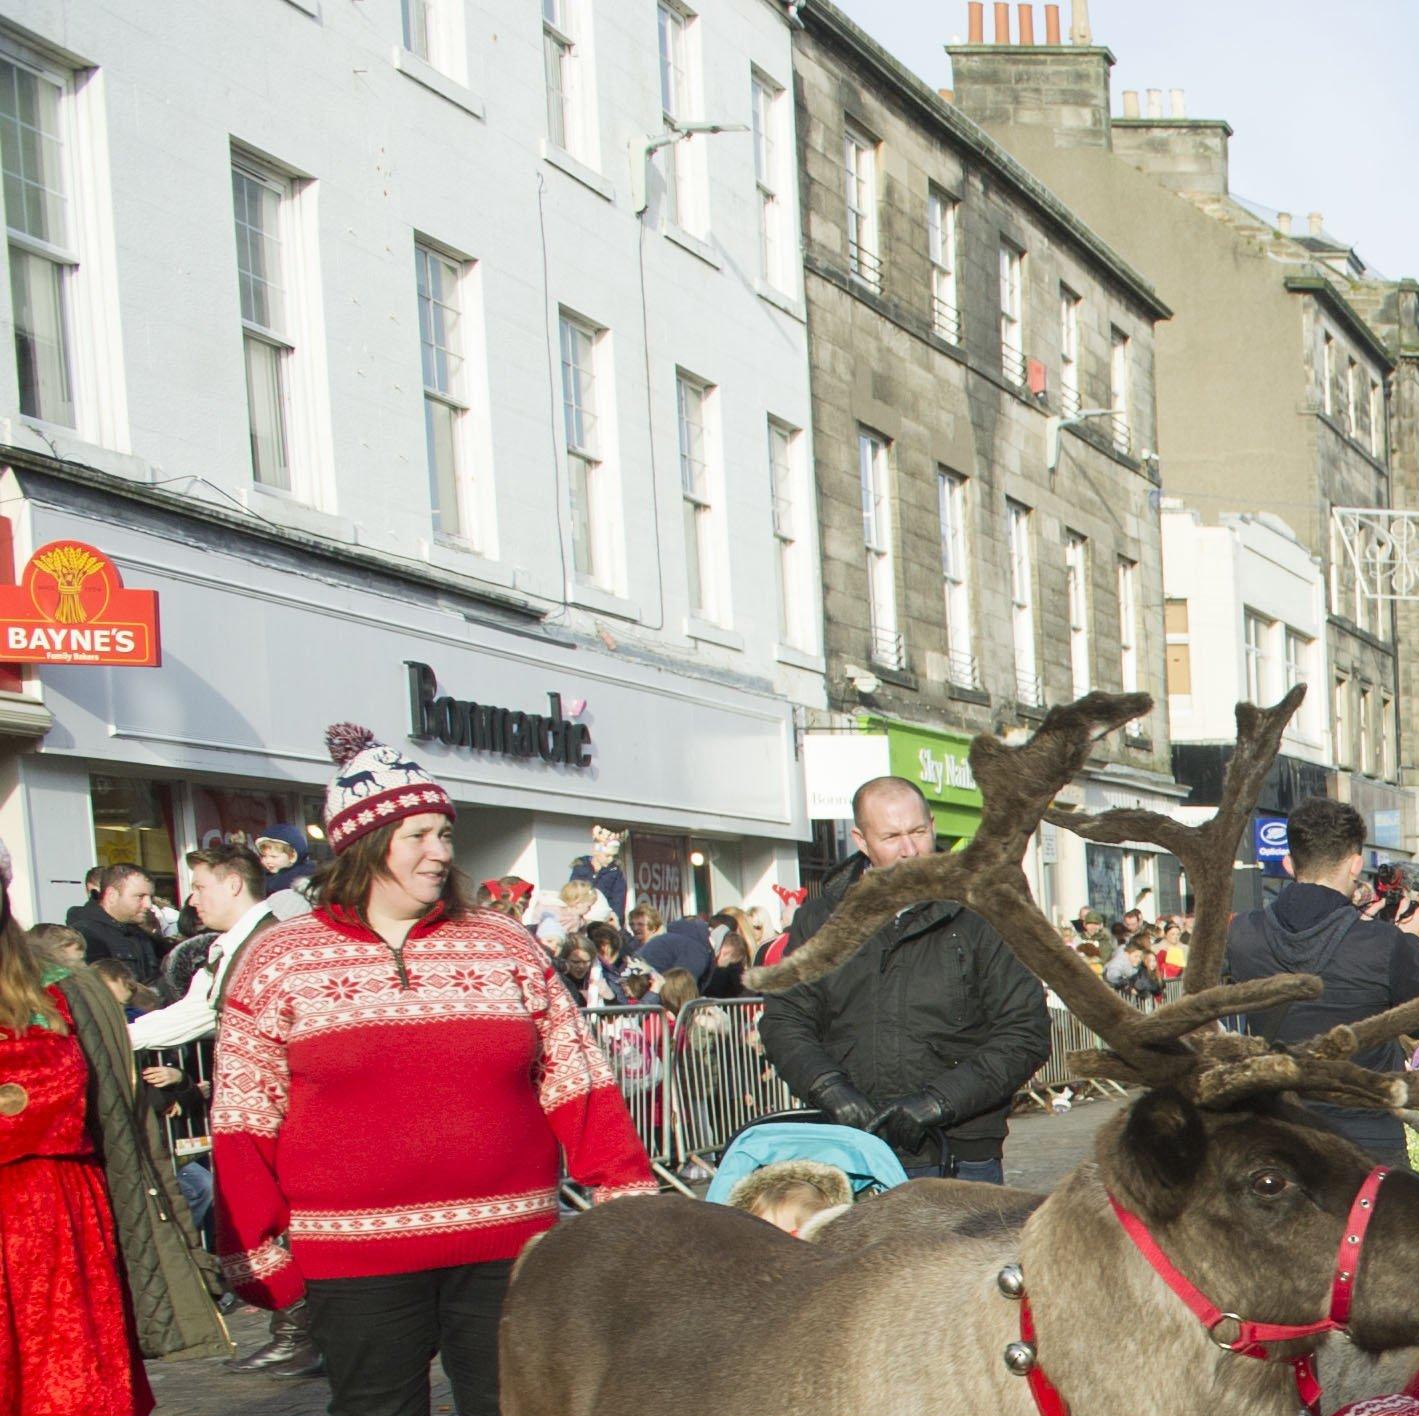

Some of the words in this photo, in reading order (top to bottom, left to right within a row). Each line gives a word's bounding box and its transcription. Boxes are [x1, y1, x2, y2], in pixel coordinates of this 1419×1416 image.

[8, 627, 135, 653] BAYNE'S
[46, 651, 72, 662] Family
[919, 748, 943, 794] Sky
